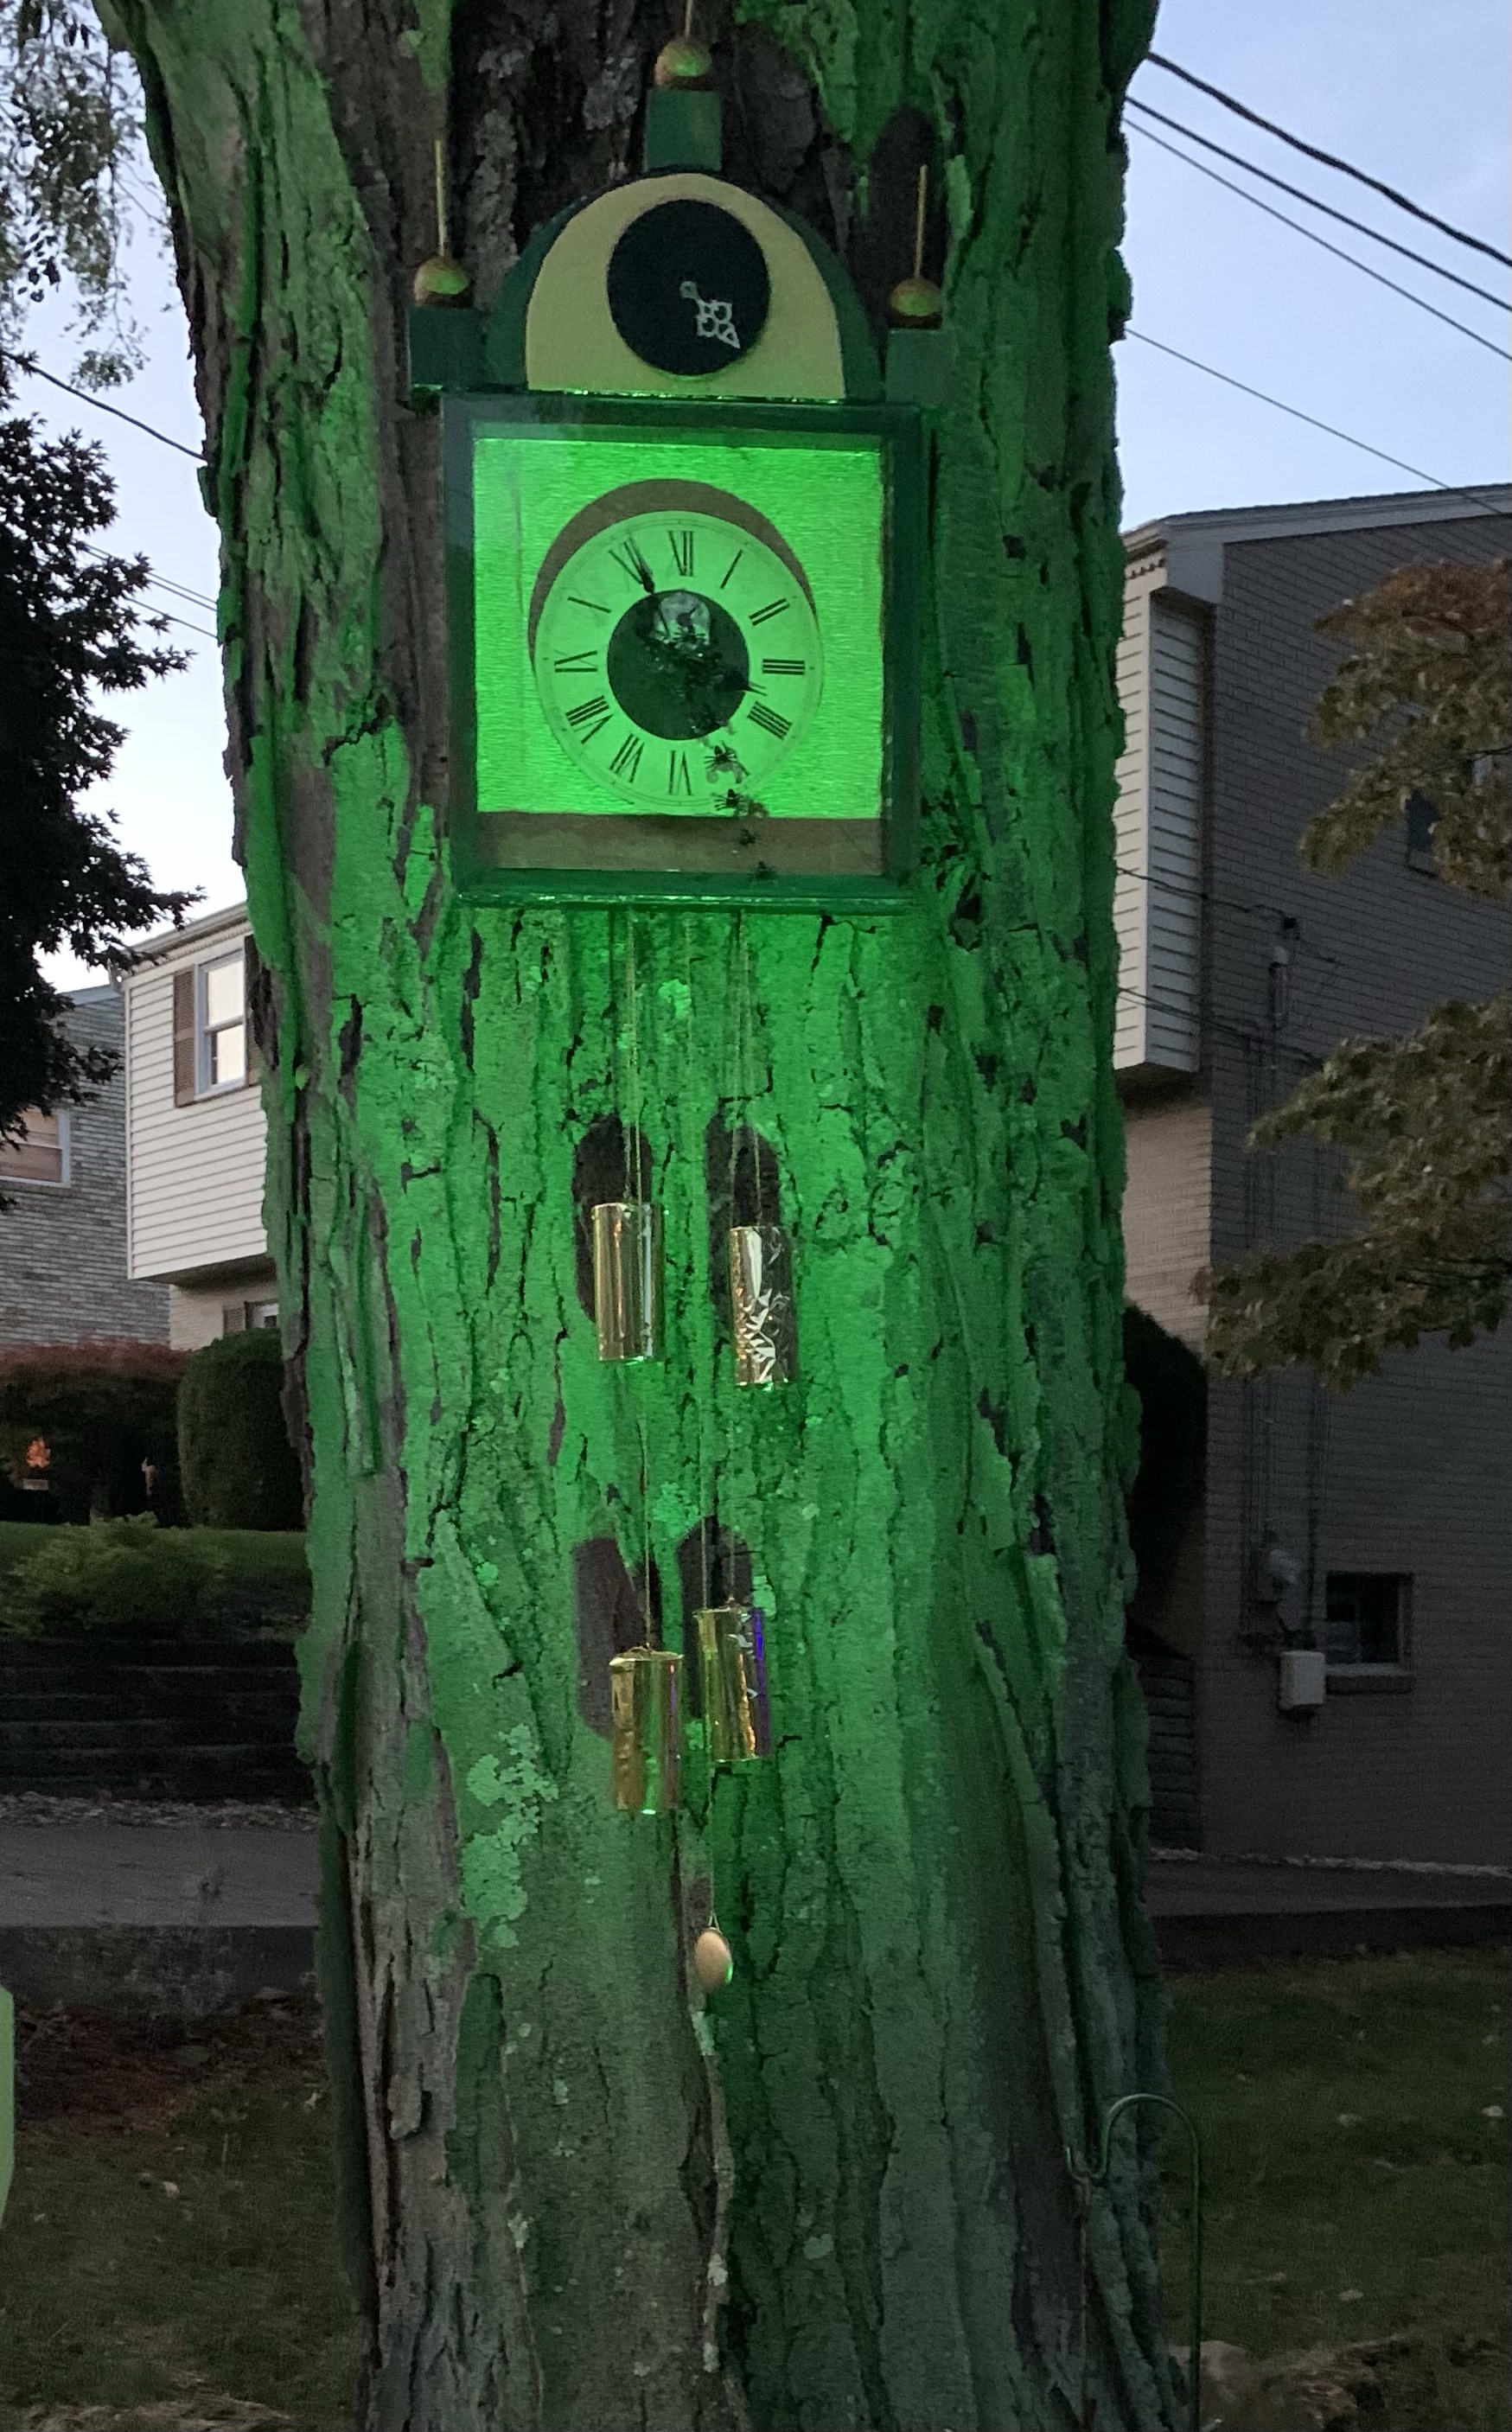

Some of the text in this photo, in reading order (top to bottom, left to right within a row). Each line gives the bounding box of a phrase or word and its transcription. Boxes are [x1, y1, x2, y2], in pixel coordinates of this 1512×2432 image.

[720, 549, 743, 590] I
[749, 597, 790, 626] II
[762, 659, 806, 675] III
